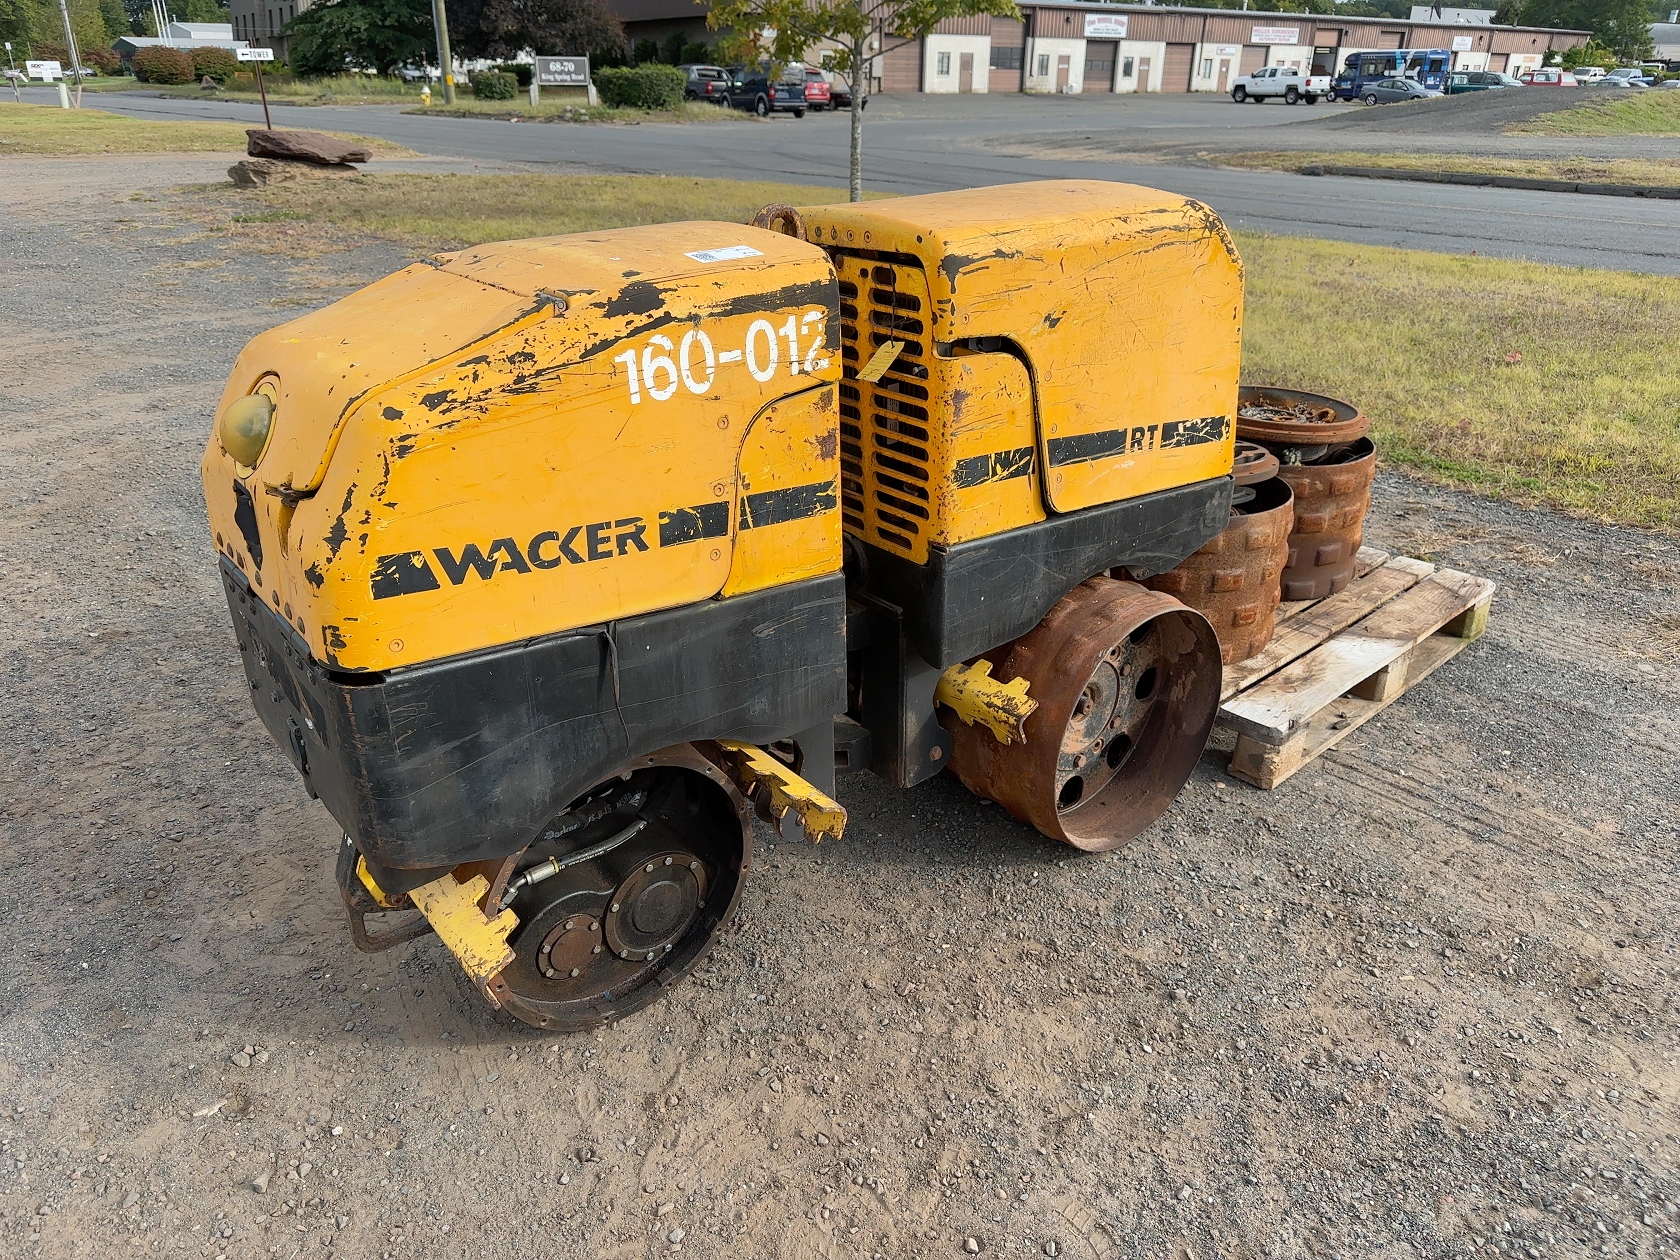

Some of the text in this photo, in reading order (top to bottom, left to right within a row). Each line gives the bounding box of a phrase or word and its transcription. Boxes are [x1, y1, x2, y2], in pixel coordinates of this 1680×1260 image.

[550, 61, 575, 72] 68-70
[614, 310, 830, 405] 160-012
[1130, 424, 1159, 453] RT
[432, 516, 650, 586] WACKER
